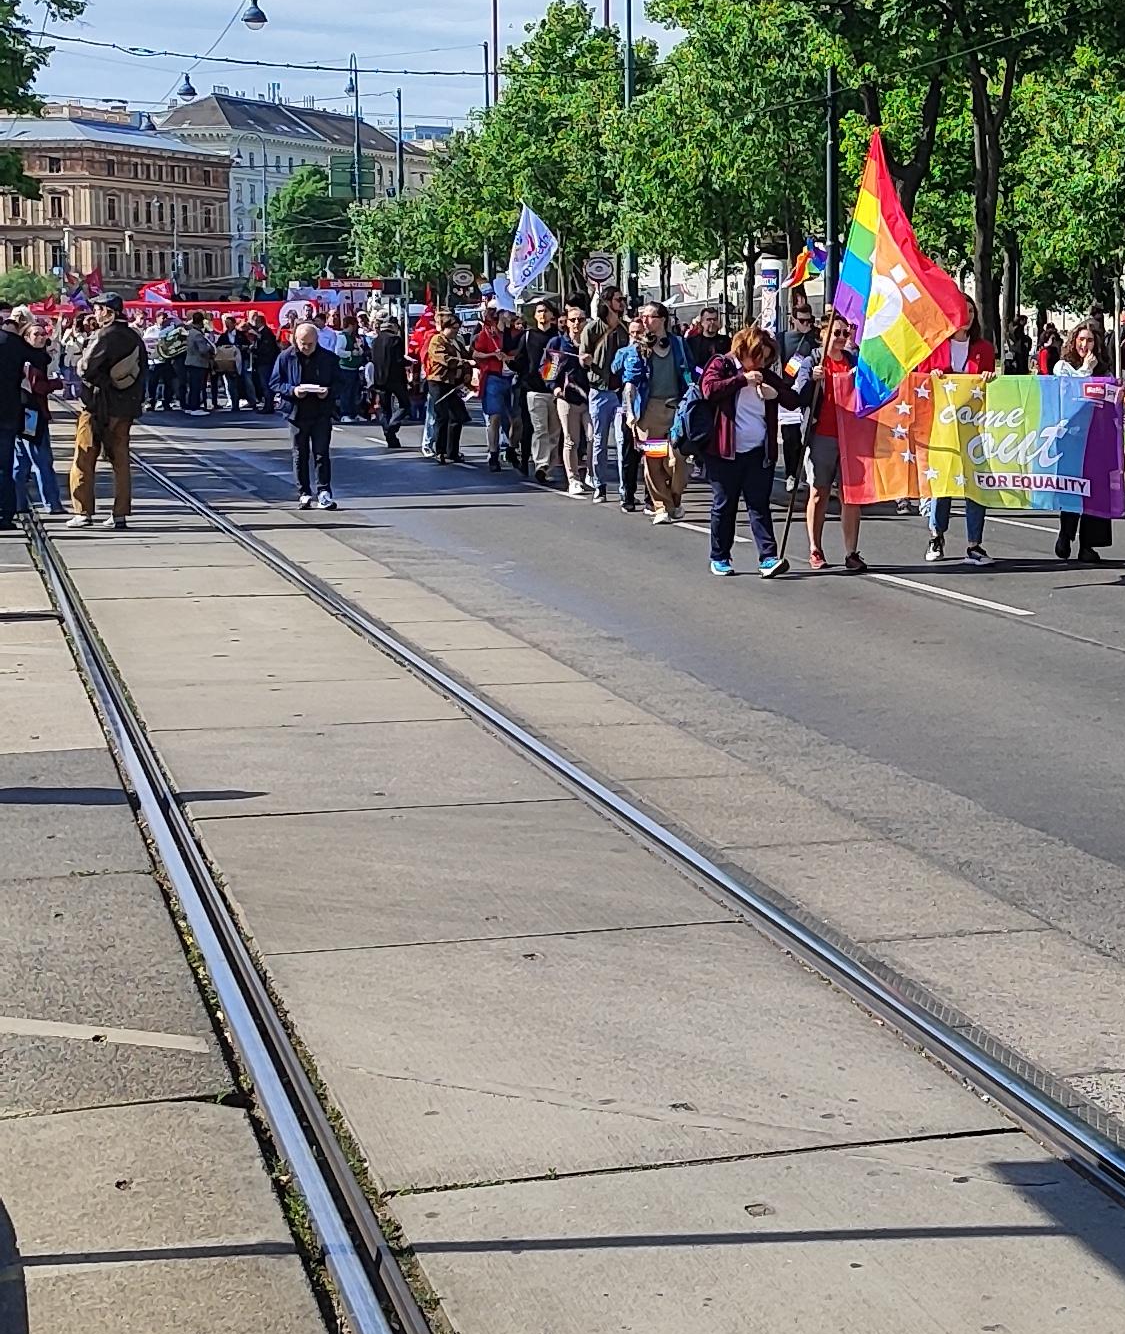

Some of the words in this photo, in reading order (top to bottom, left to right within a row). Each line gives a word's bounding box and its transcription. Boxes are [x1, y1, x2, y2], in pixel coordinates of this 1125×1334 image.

[940, 403, 1025, 427] come
[967, 419, 1069, 467] out
[976, 474, 1008, 488] FOR
[1011, 475, 1087, 494] EQUALITY
